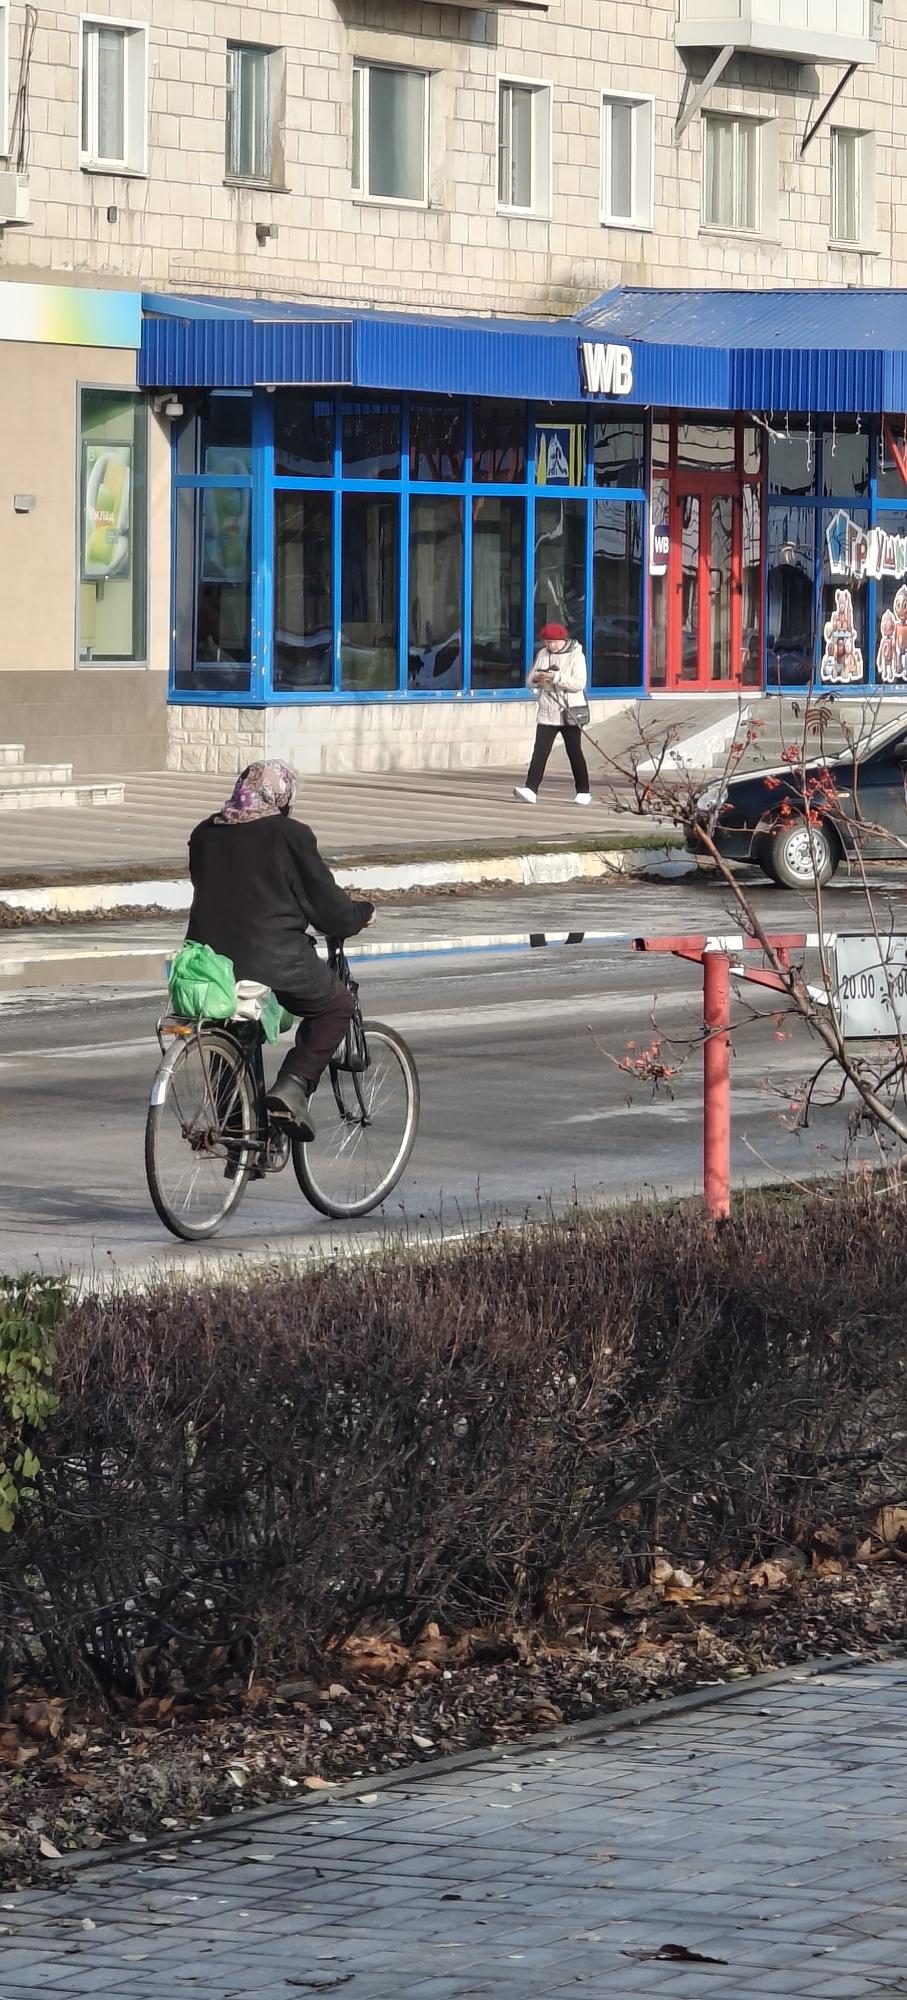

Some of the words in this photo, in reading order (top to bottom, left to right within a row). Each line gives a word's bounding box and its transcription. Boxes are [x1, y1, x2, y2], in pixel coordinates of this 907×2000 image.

[583, 342, 633, 394] WB
[655, 536, 670, 554] WB
[842, 974, 875, 999] 20.00
